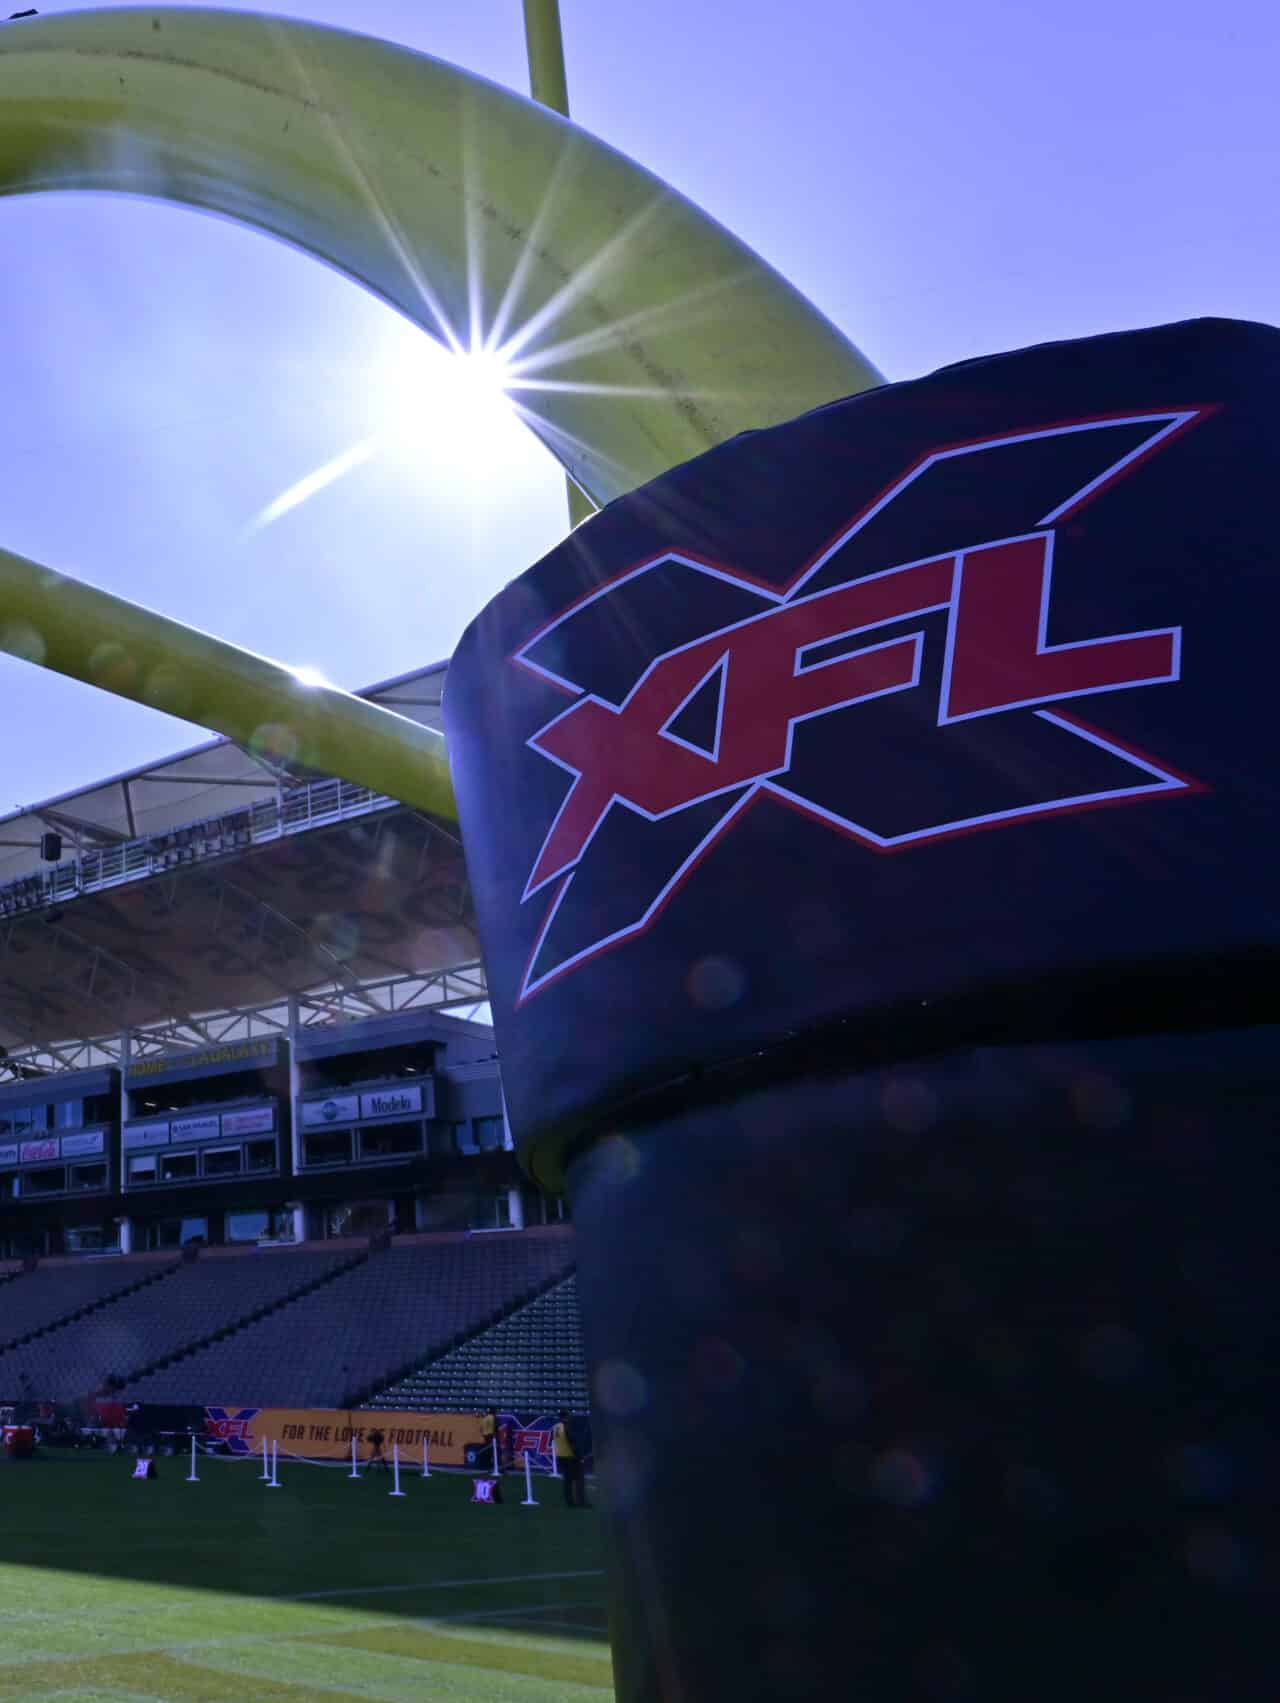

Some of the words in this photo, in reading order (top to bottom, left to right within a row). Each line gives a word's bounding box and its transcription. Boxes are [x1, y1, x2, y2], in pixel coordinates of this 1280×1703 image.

[520, 529, 1182, 904] XFL
[371, 1094, 411, 1113] Modelo
[205, 1420, 254, 1440] XFL
[282, 1423, 305, 1441] FOR
[309, 1424, 331, 1441] THE
[334, 1425, 363, 1442] LOVE
[388, 1428, 454, 1448] FOOTBALL
[476, 1481, 490, 1498] 10
